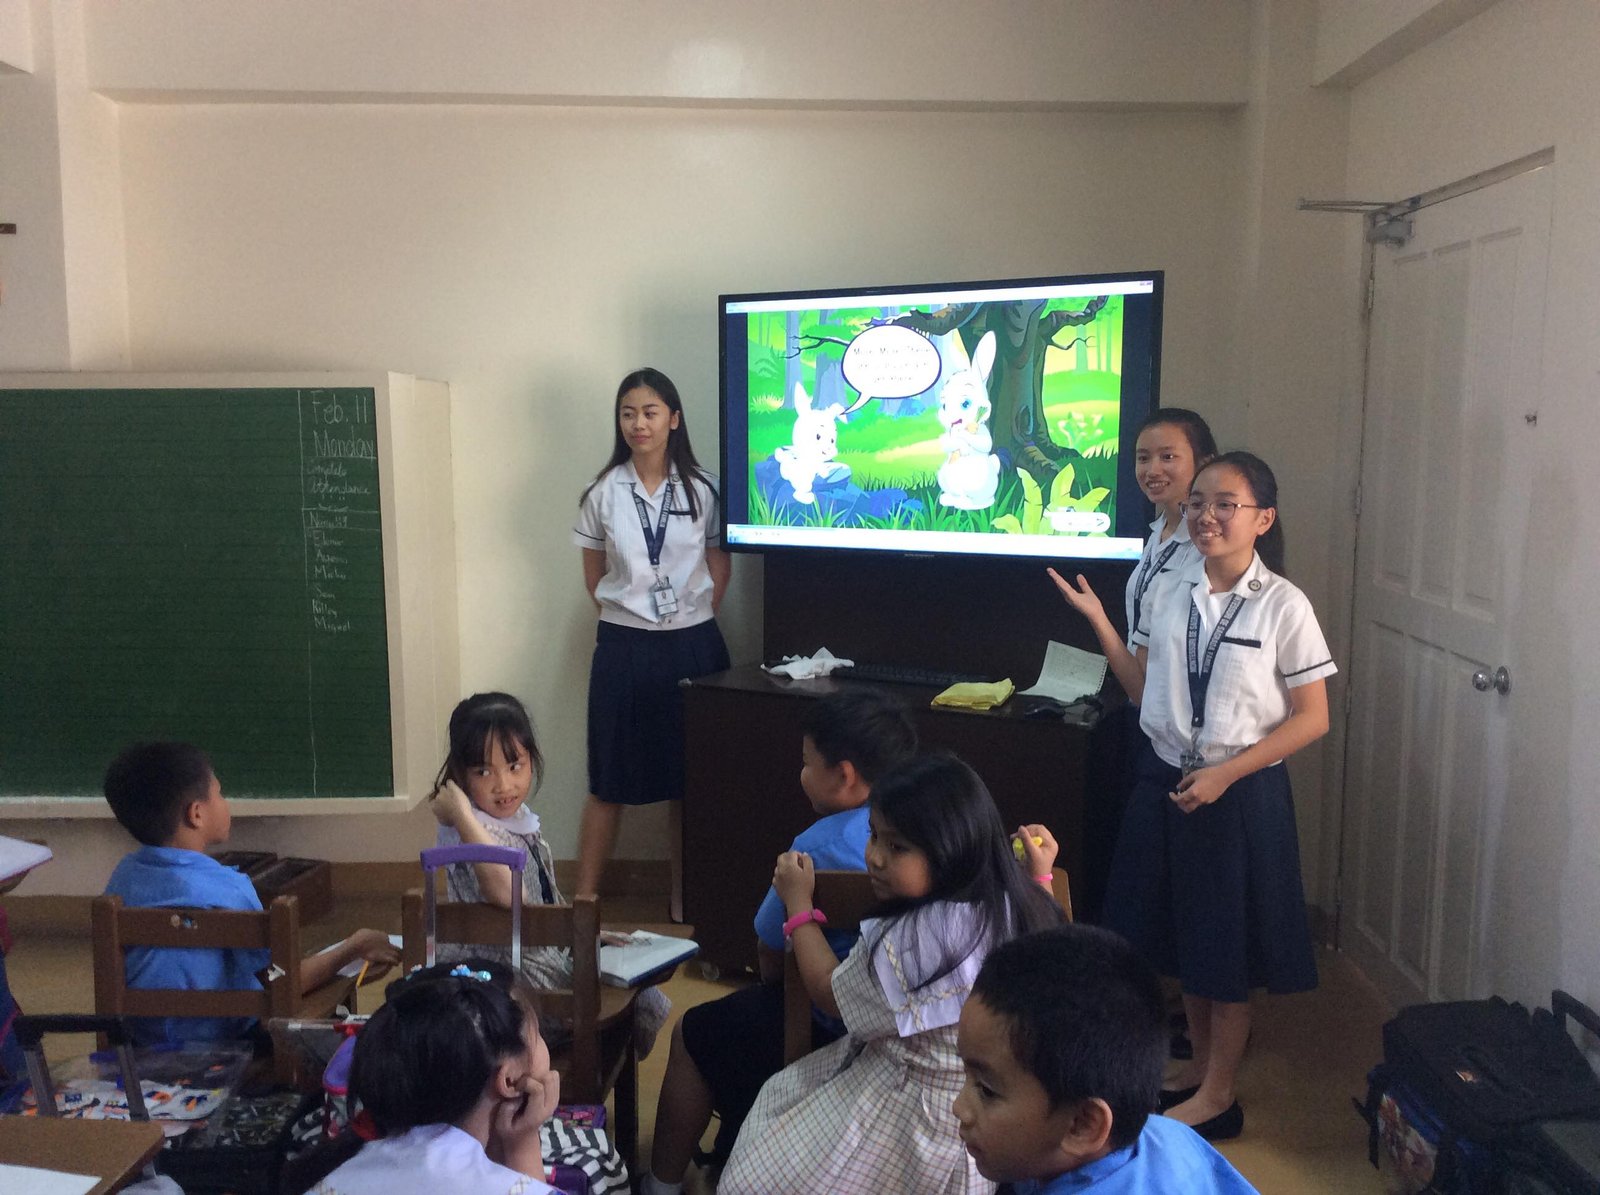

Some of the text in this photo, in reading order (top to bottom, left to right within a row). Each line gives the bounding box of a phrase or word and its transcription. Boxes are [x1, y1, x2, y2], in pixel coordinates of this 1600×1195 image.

[310, 389, 368, 425] Feb. 11
[313, 425, 374, 464] Monday
